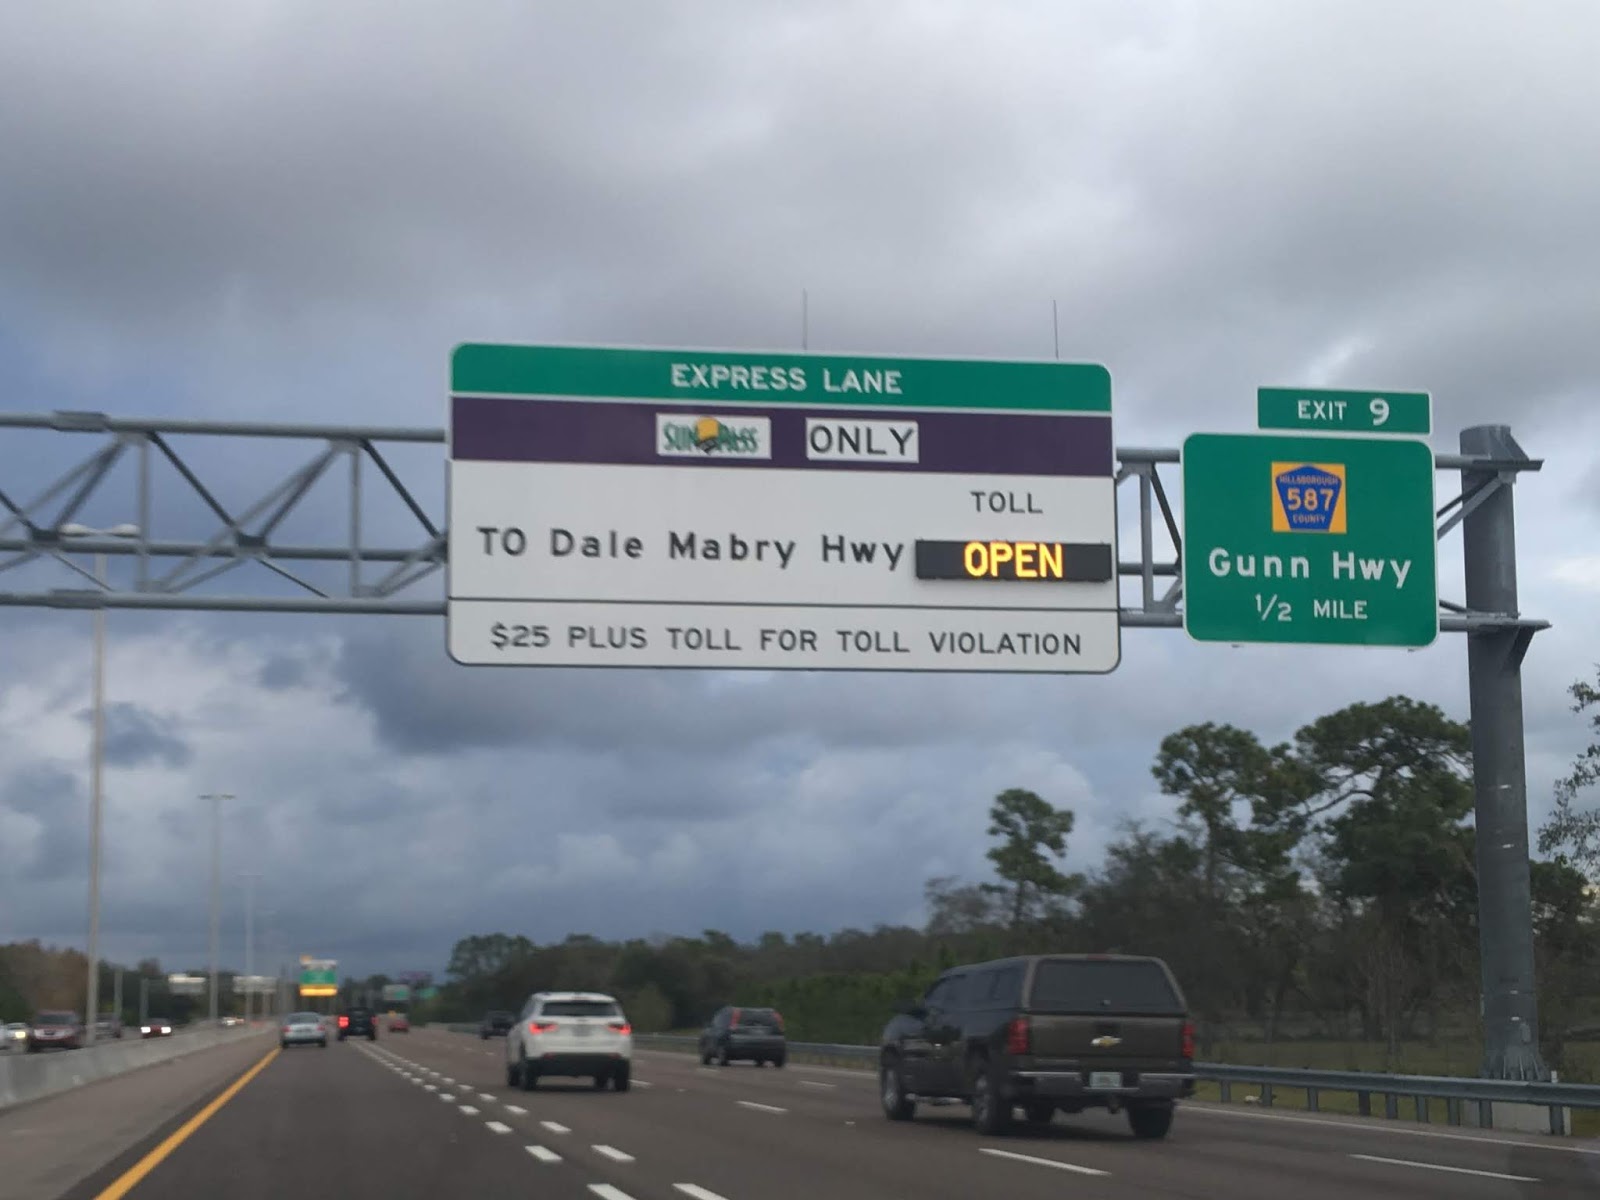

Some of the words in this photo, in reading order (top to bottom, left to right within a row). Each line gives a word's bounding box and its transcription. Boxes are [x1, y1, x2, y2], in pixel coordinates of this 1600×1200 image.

[671, 363, 807, 392] EXPRESS
[823, 368, 903, 394] LANE
[1298, 400, 1347, 421] EXIT
[1369, 398, 1390, 426] 9
[810, 425, 914, 456] ONLY
[970, 491, 1043, 514] TOLL
[1287, 488, 1334, 512] 587
[1292, 514, 1326, 524] COUNTY
[477, 526, 527, 556] TO
[551, 528, 644, 558] Dale
[669, 531, 795, 570] Mabry
[822, 534, 904, 571] Hwy
[964, 541, 1064, 578] OPEN
[1209, 547, 1310, 578] Gunn
[1332, 551, 1412, 589] Hwy
[1314, 599, 1368, 620] MILE
[490, 621, 550, 651] $25
[568, 625, 648, 649] PLUS
[666, 628, 742, 650] TOLL
[760, 629, 818, 652] FOR
[838, 630, 911, 653] TOLL
[929, 631, 1081, 655] VIOLATION
